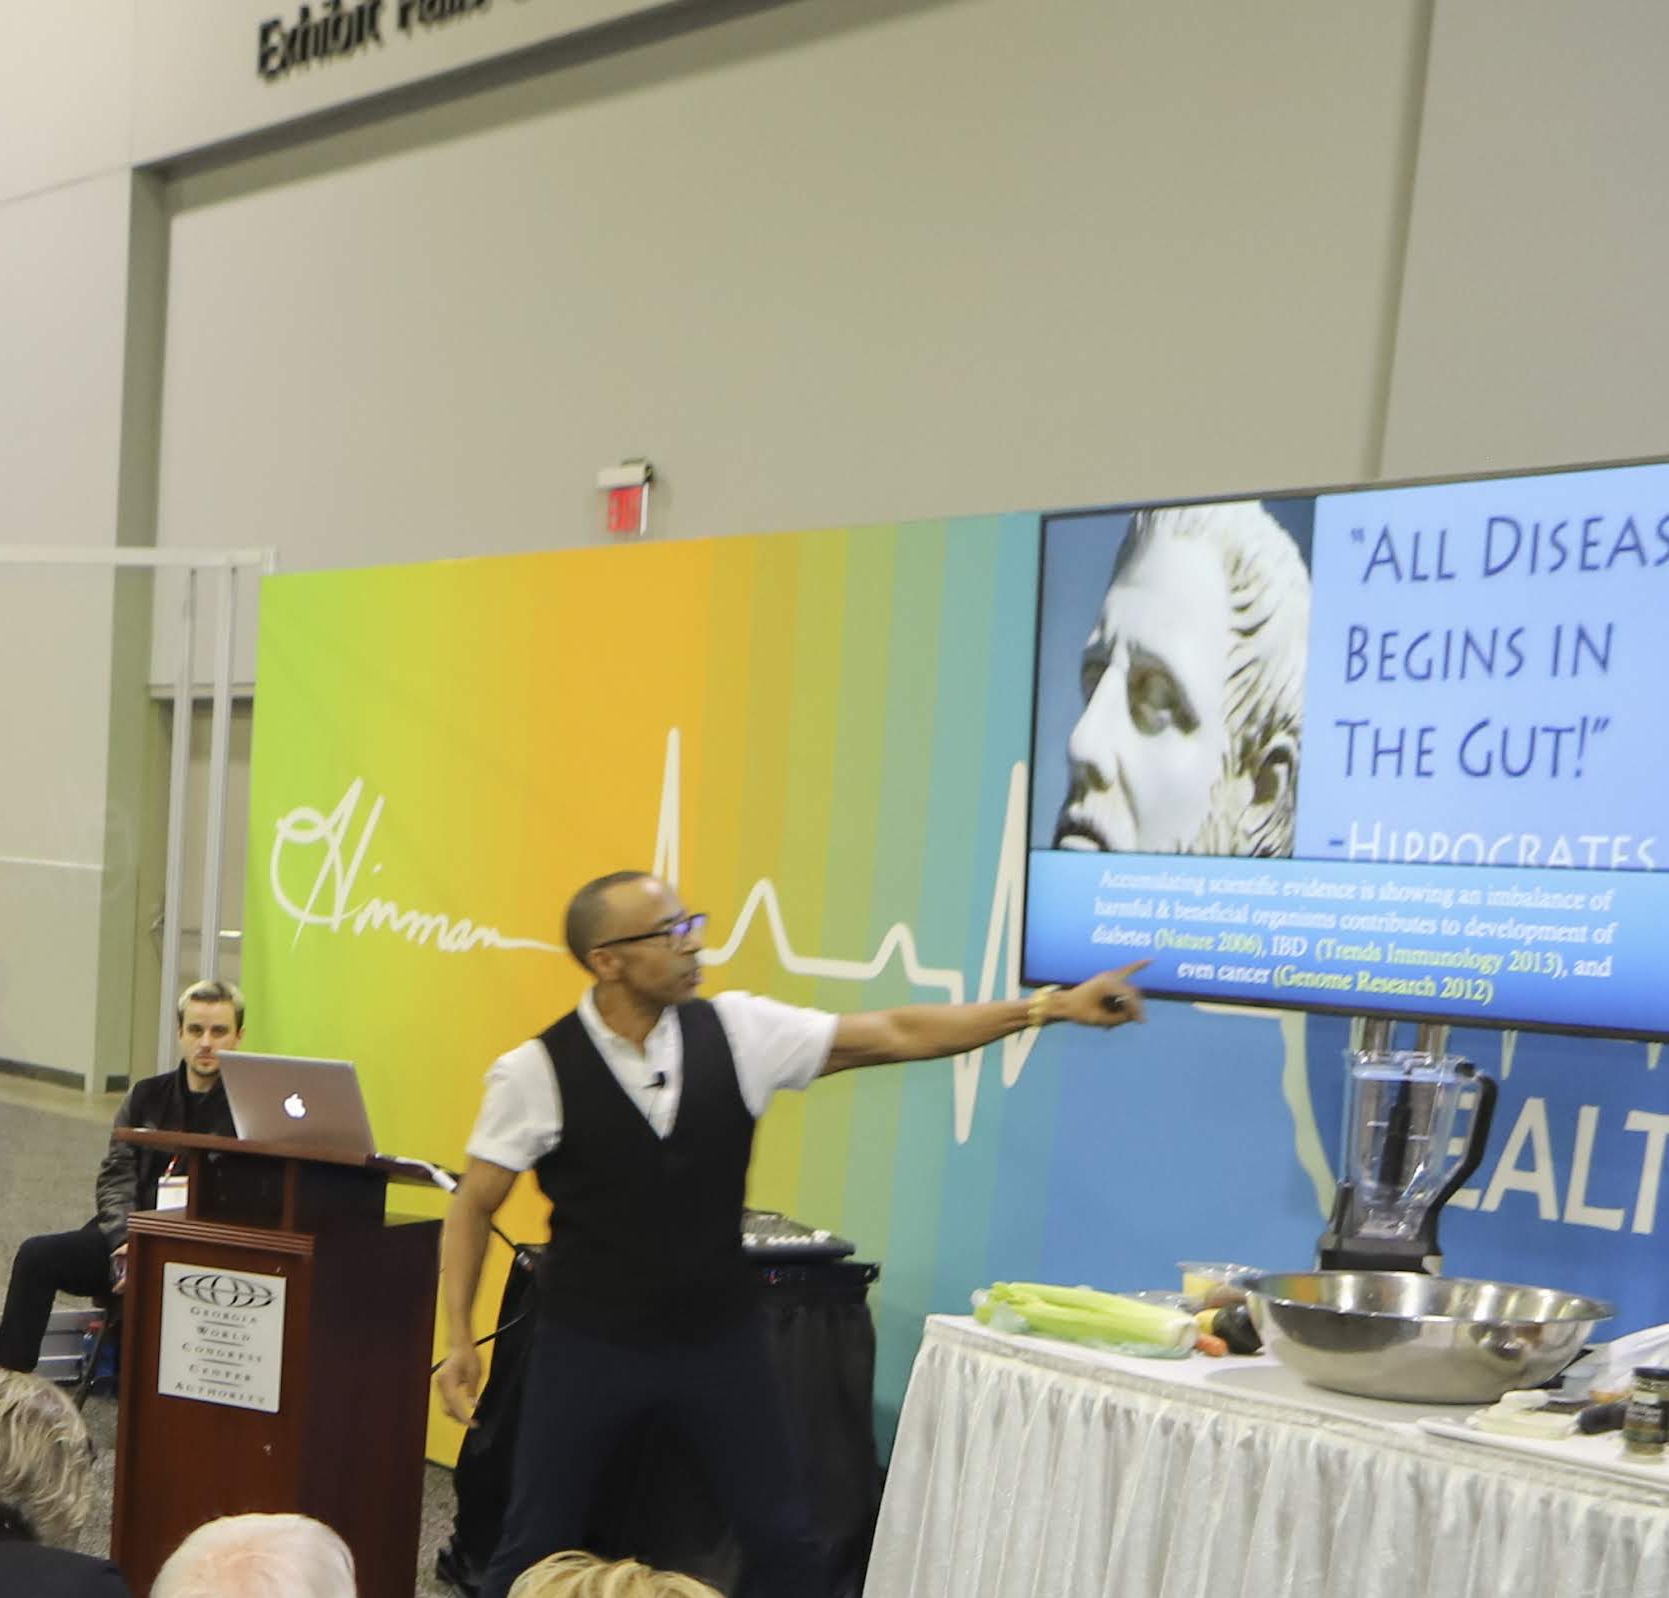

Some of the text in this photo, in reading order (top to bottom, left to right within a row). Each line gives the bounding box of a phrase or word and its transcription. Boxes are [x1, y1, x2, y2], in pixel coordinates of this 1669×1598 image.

[1344, 621, 1615, 684] BEGINS IN
[1334, 718, 1437, 779] THE
[1100, 869, 1615, 912] Accumulating scientific evidence is showing an imbalance of
[1155, 900, 1171, 920] &
[1174, 901, 1250, 924] beneficial
[1252, 907, 1337, 930] organisms
[1340, 911, 1437, 935] contributes
[1441, 917, 1461, 937] to
[1465, 914, 1588, 945] development
[1592, 921, 1619, 945] of
[1091, 924, 1152, 947] diabetes
[1154, 928, 1215, 951] (Nature
[1270, 935, 1308, 957] IBD
[1315, 937, 1382, 962] (Trends
[1386, 942, 1504, 975] Immunology
[1508, 950, 1569, 980] 2013),
[1573, 956, 1614, 978] and
[1177, 962, 1495, 1006] even cancer (Genome Research 2012)
[1445, 1092, 1669, 1234] EALT
[189, 1306, 257, 1323] GEORGIA
[197, 1326, 251, 1342] WORLD
[181, 1342, 262, 1363] CONGRESS
[188, 1363, 251, 1382] CENTER
